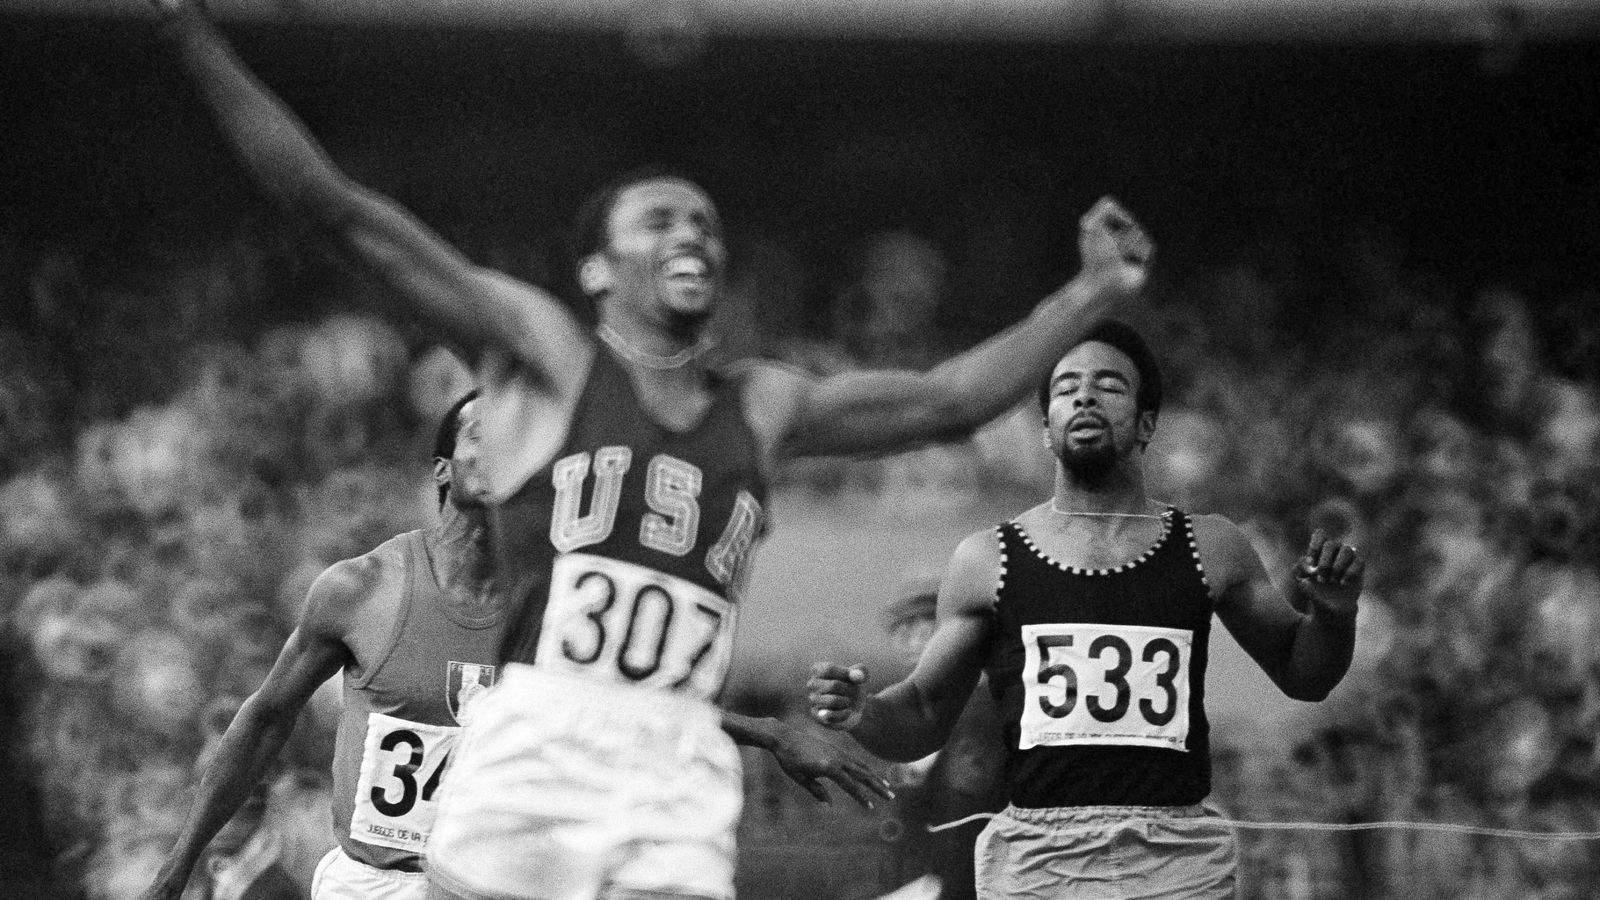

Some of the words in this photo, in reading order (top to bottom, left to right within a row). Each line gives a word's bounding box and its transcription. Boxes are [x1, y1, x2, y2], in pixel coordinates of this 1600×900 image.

[550, 445, 762, 586] USA
[561, 570, 723, 689] 307
[1037, 634, 1180, 726] 533
